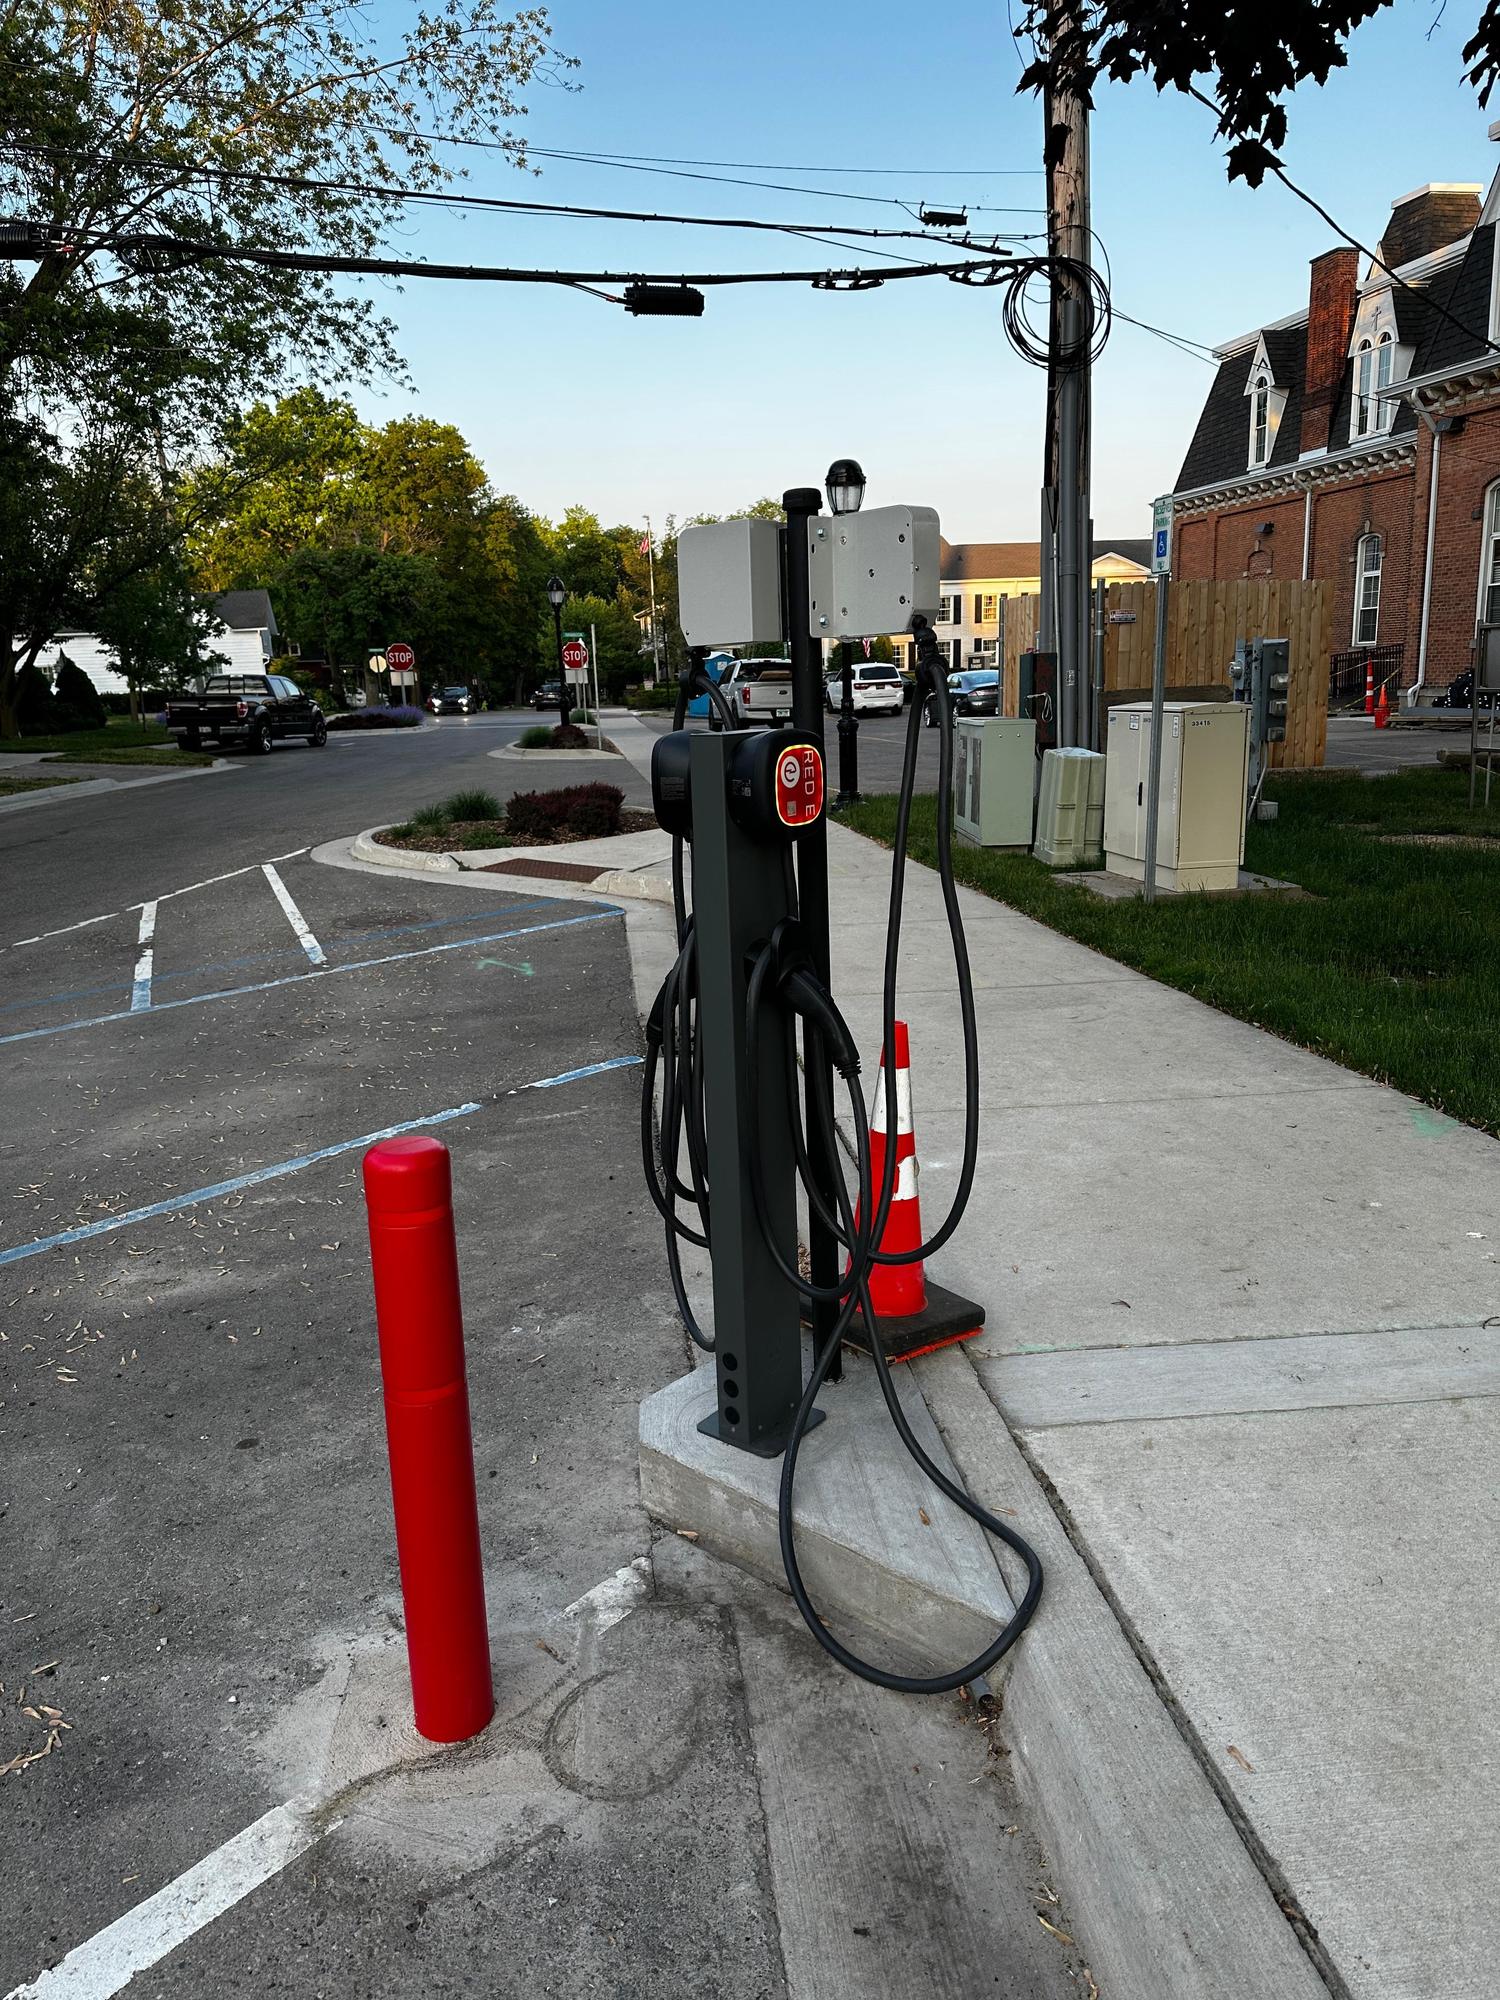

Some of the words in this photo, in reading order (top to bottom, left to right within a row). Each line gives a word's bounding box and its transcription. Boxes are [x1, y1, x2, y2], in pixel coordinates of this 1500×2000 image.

[388, 652, 412, 663] STOP
[563, 650, 587, 661] STOP
[803, 750, 815, 795] RED
[805, 804, 816, 817] E
